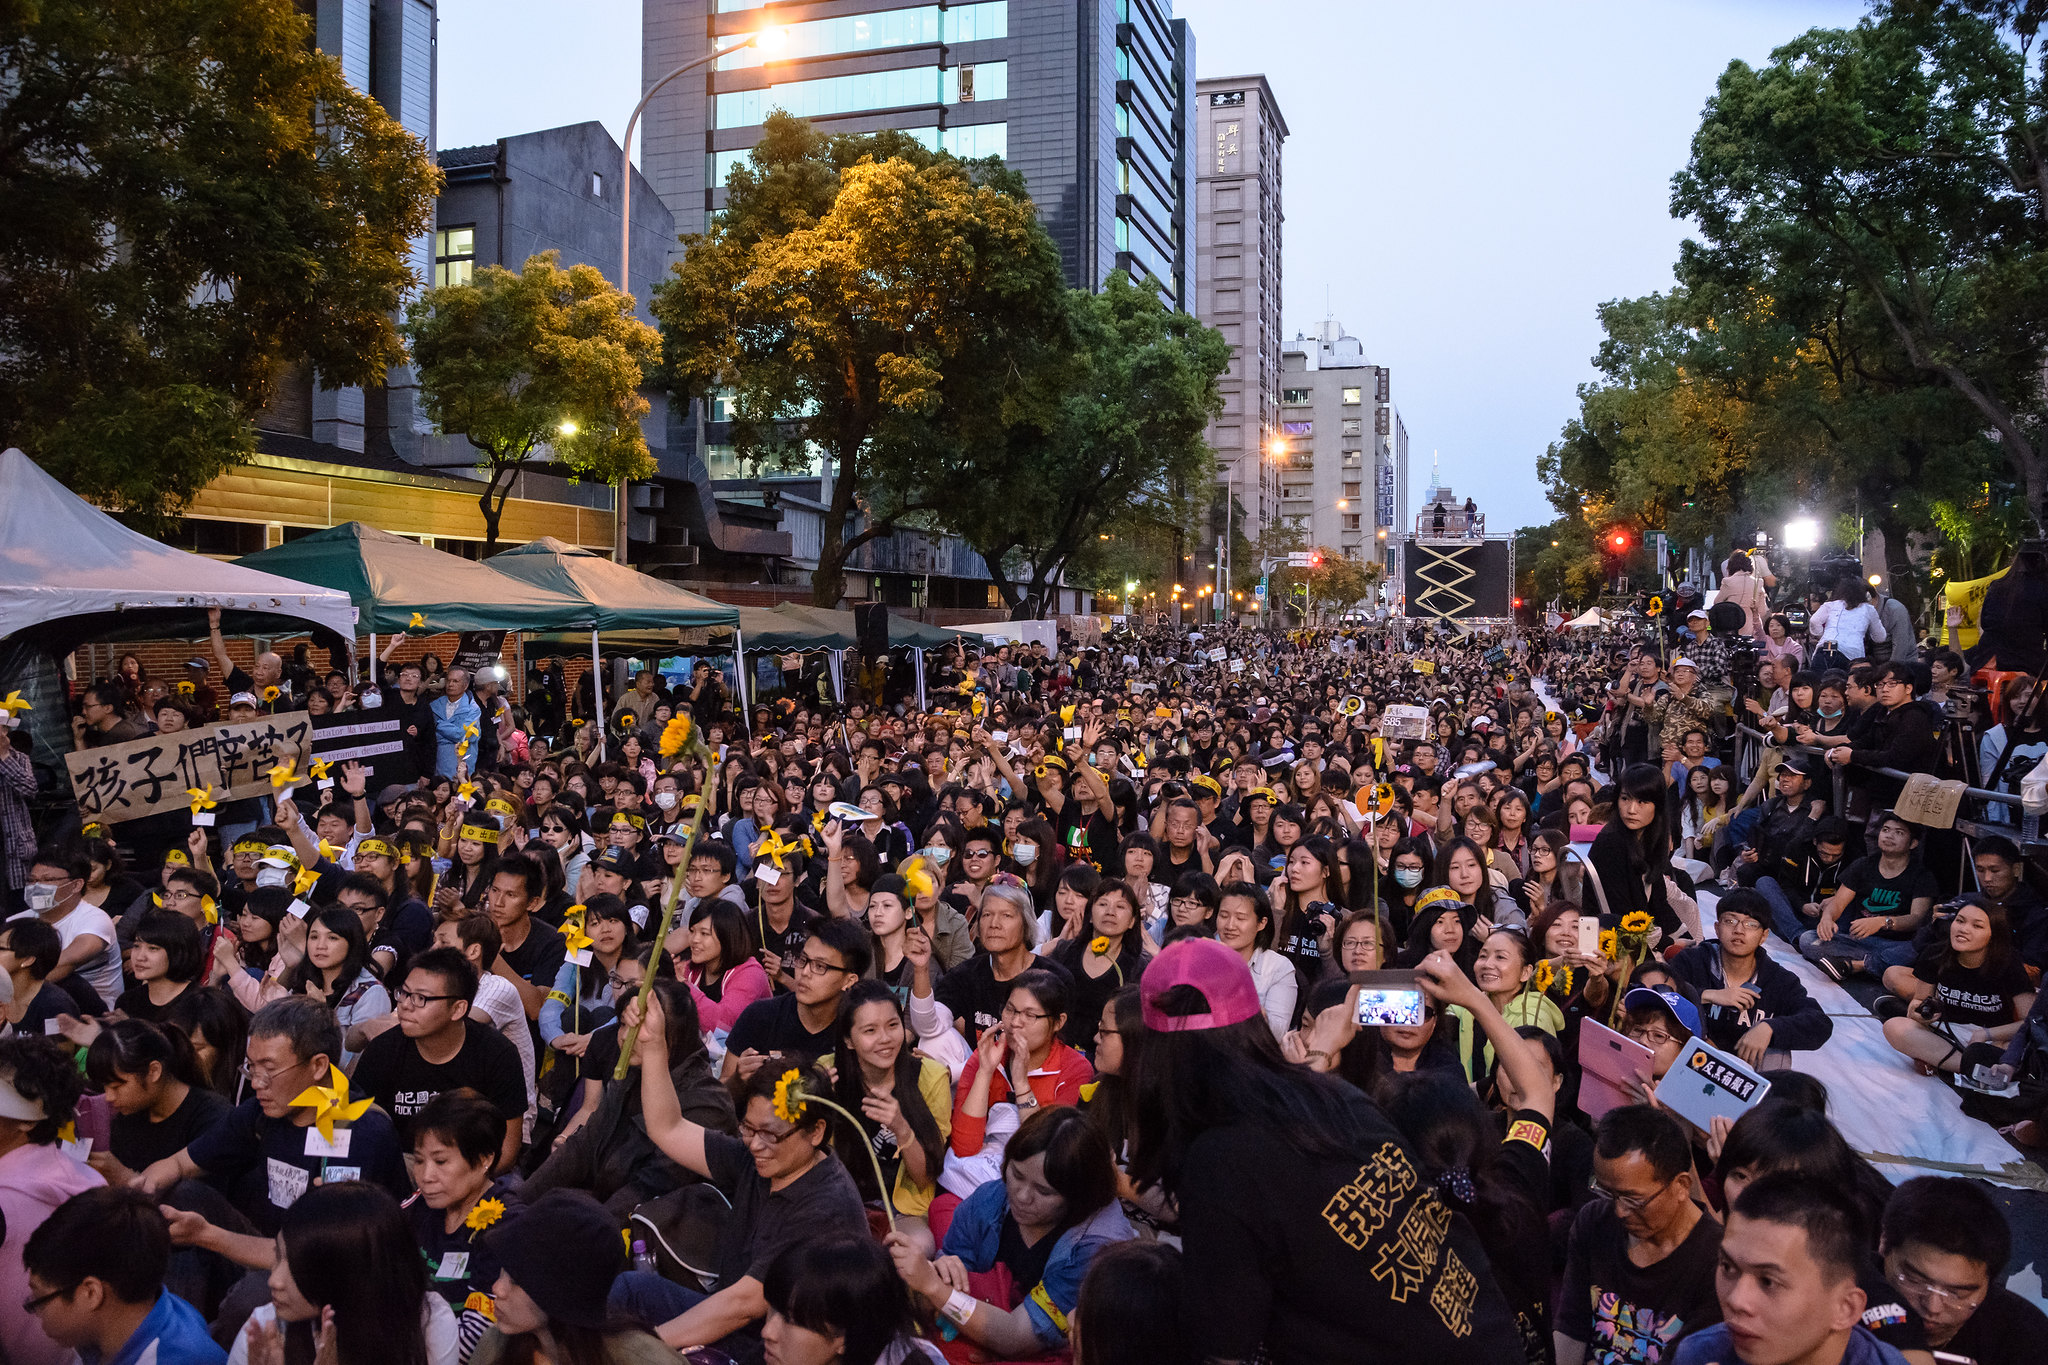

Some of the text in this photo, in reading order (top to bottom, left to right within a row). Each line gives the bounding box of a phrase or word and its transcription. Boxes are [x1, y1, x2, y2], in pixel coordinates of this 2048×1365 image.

[1384, 716, 1401, 727] 585
[328, 749, 358, 761] tyranny
[361, 742, 402, 756] devastates
[75, 721, 309, 813] 孩子們辛苦了
[1870, 887, 1901, 906] NIKE
[1702, 1060, 1754, 1098] 反黑箱服貿
[395, 1104, 411, 1115] FUCK
[1321, 1142, 1417, 1250] 我支持
[1370, 1187, 1453, 1303] 太陽花
